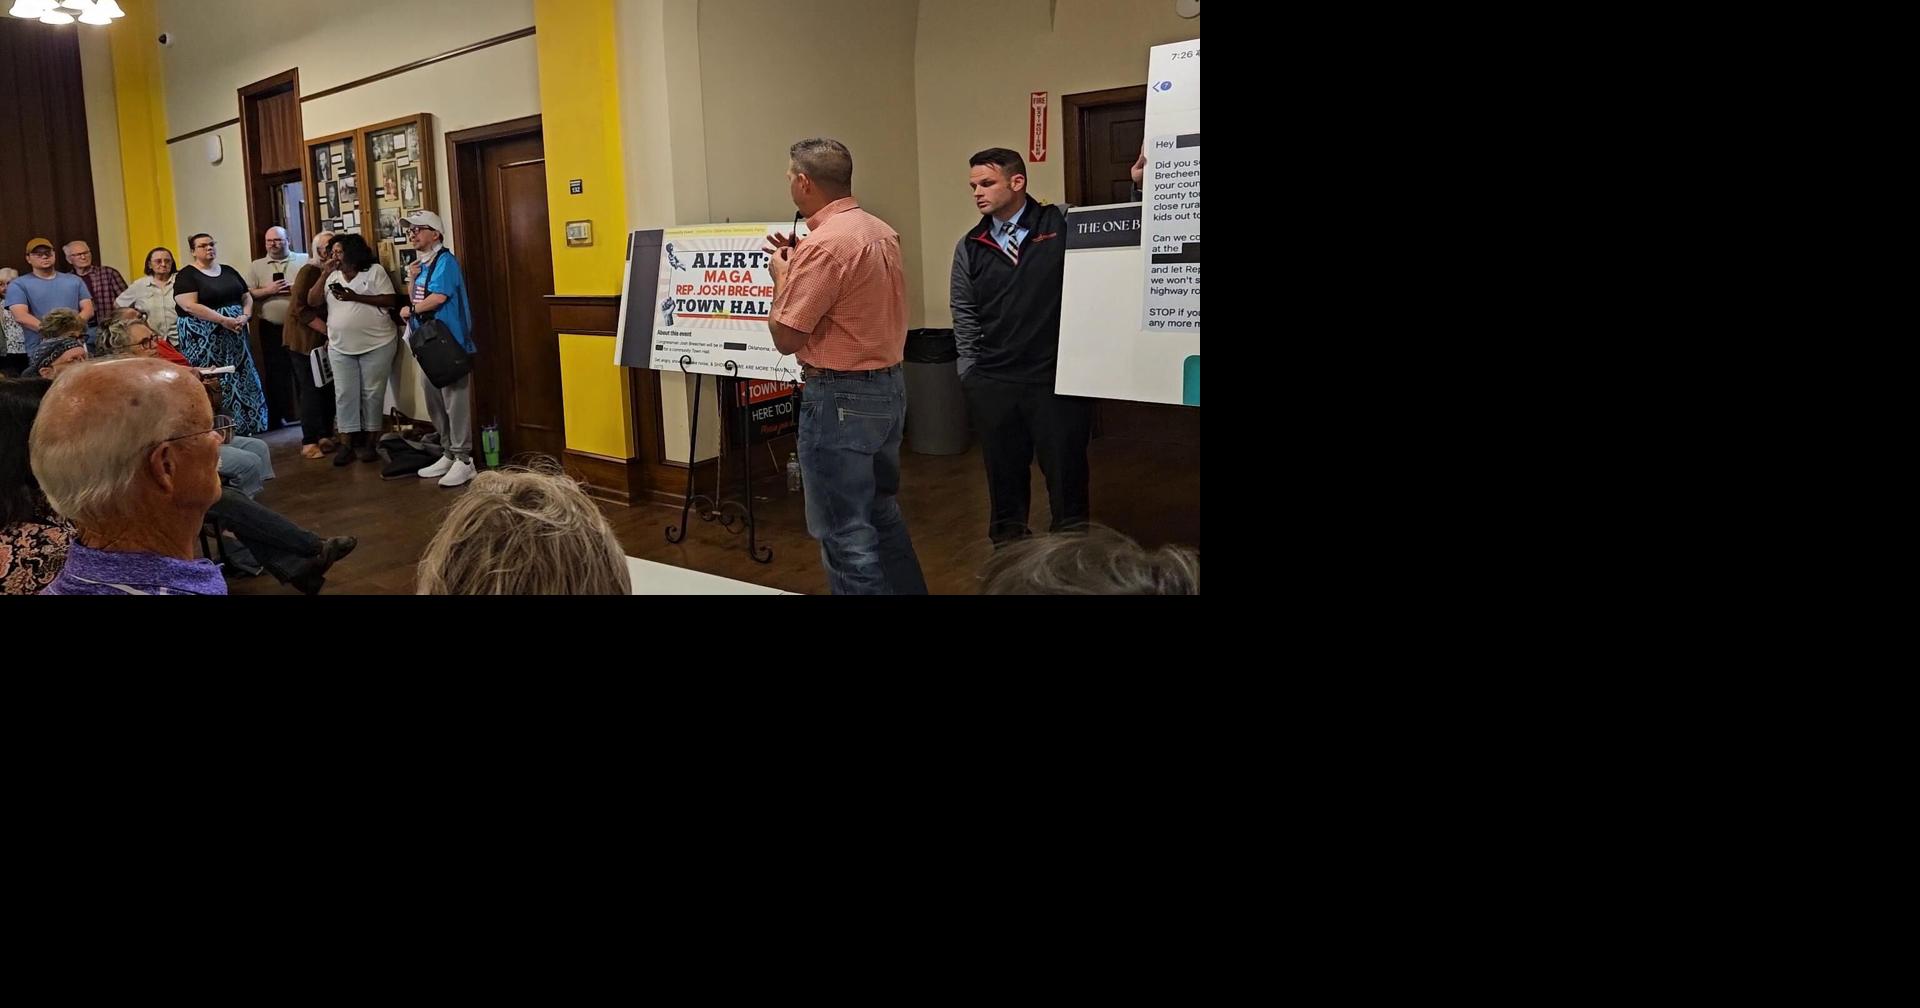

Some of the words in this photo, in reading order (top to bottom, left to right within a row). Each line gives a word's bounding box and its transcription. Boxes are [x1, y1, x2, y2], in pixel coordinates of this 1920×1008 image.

[1172, 50, 1193, 60] 7:26
[1156, 140, 1174, 148] Hey
[1156, 161, 1171, 169] Did
[1174, 161, 1190, 170] you
[1155, 170, 1200, 180] Brecheen
[1154, 183, 1174, 191] your
[1154, 192, 1186, 200] county
[1077, 222, 1100, 234] THE
[1102, 220, 1130, 232] ONE
[692, 253, 769, 268] ALERT:
[704, 270, 752, 283] MAGA
[1166, 276, 1192, 284] won't
[676, 284, 696, 295] REP.
[697, 285, 726, 296] JOSH
[1150, 287, 1188, 296] highway
[676, 299, 725, 313] TOWN
[730, 300, 772, 315] HAL
[1150, 308, 1176, 316] STOP
[1178, 308, 1184, 316] if
[1149, 320, 1165, 328] any
[749, 381, 777, 398] TOWN
[752, 406, 774, 422] HERE
